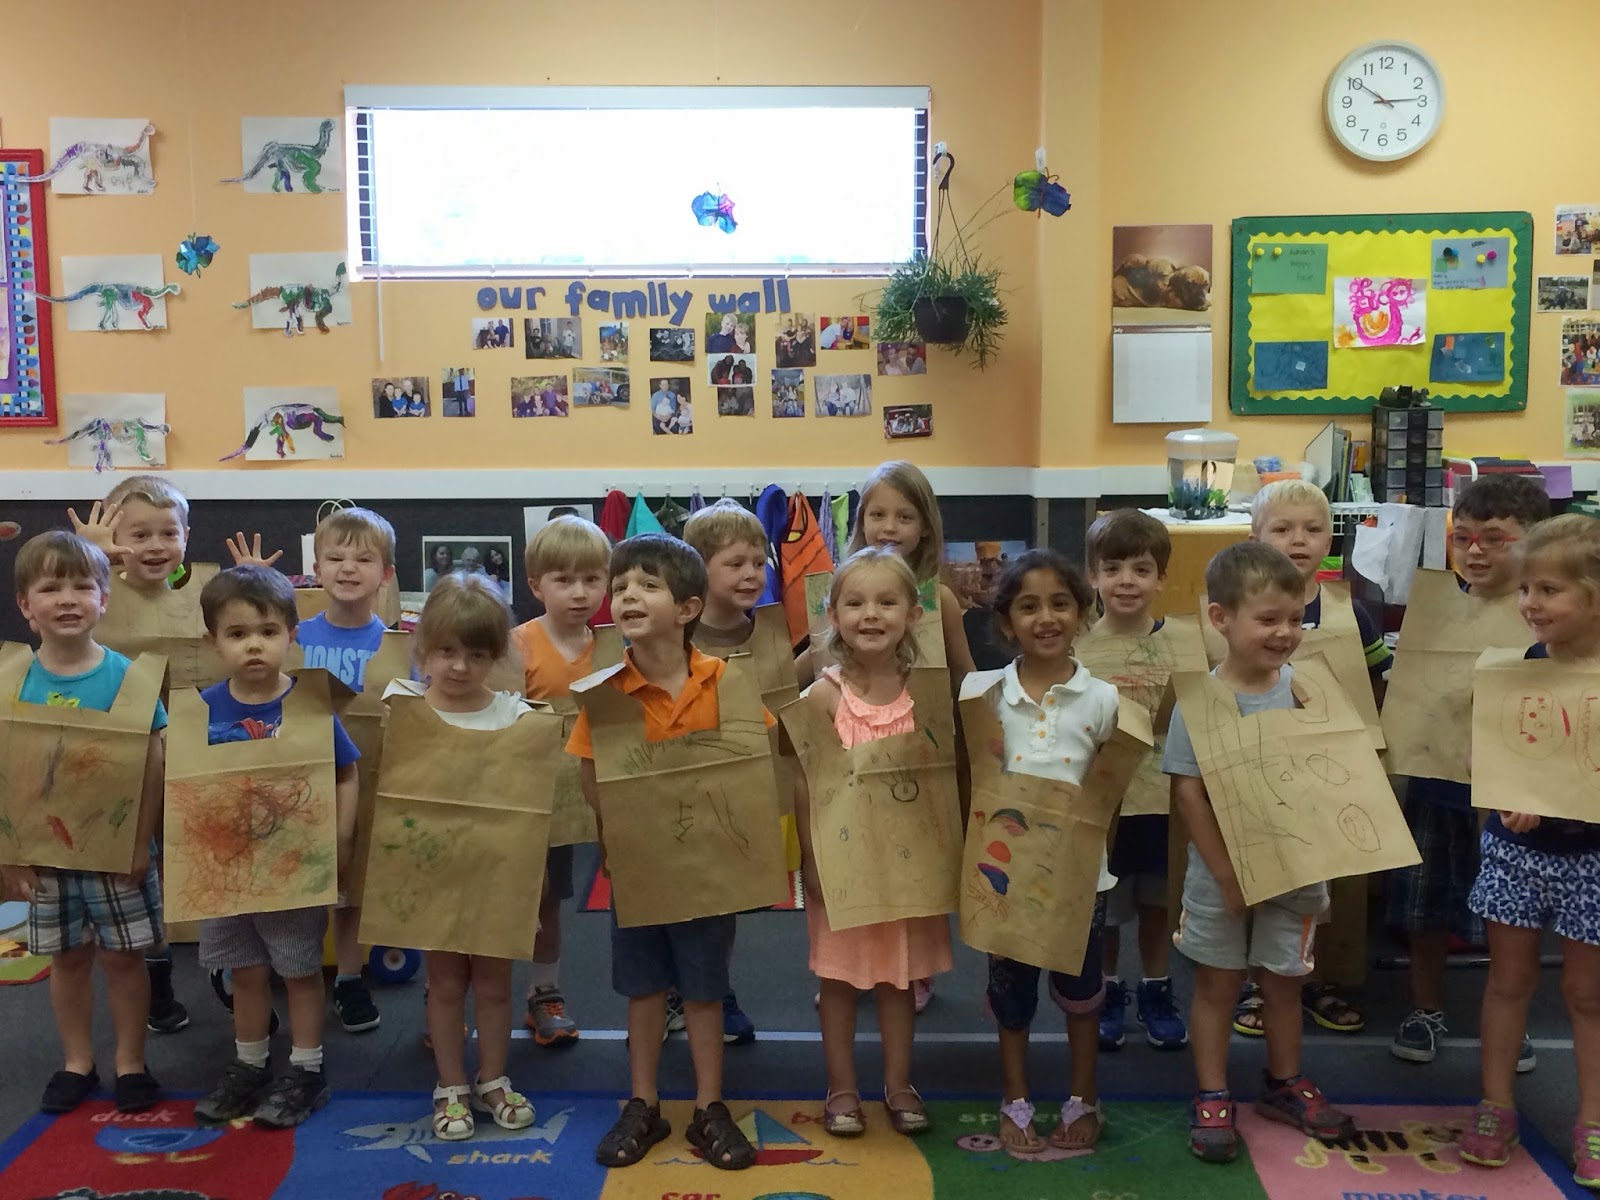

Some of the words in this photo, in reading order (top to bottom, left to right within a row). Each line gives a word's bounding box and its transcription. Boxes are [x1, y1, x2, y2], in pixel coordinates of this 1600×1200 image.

[1362, 63, 1374, 75] 11
[1379, 56, 1394, 70] 12
[1403, 62, 1408, 75] 1
[1347, 77, 1363, 90] 10
[1413, 77, 1424, 90] 2
[1341, 96, 1353, 108] 9
[1417, 95, 1428, 107] 3
[1346, 115, 1357, 128] 8
[1411, 114, 1421, 127] 4
[1360, 128, 1369, 142] 7
[1377, 134, 1388, 147] 6
[1396, 128, 1407, 141] 5
[477, 287, 546, 311] our
[708, 278, 791, 314] wall
[90, 1109, 177, 1122] duck
[447, 1149, 553, 1164] shark
